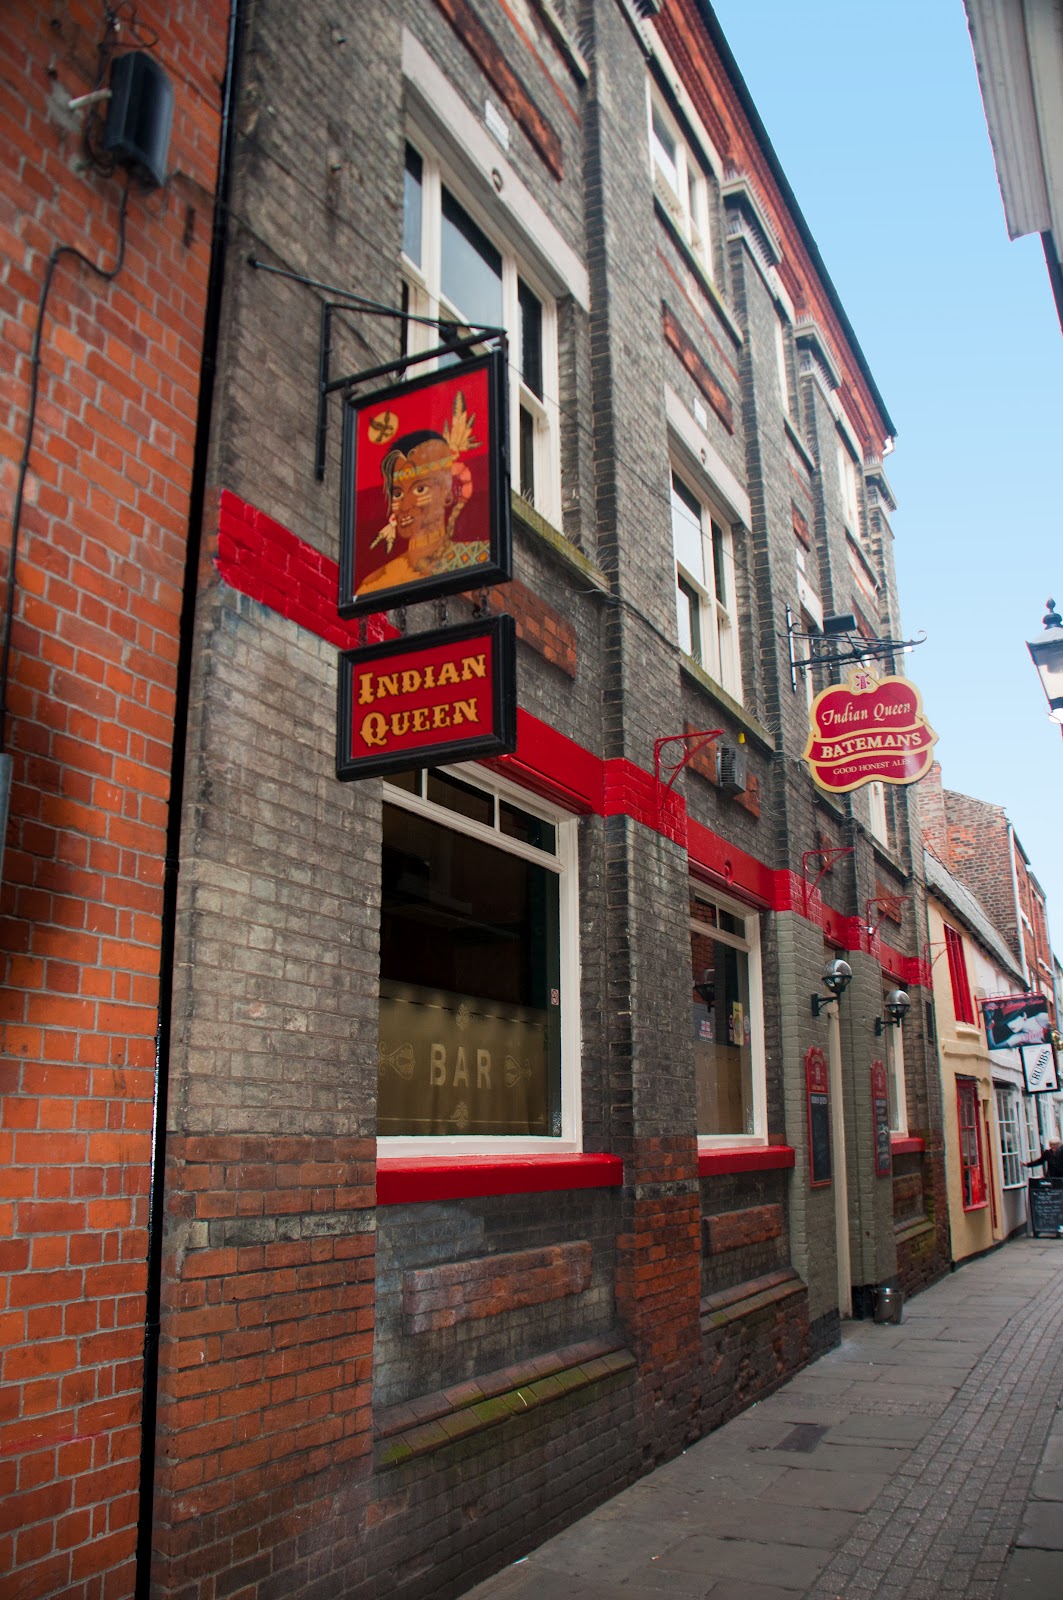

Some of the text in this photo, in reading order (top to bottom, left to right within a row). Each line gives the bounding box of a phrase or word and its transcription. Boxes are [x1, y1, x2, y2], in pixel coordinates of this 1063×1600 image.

[357, 653, 487, 706] INDIAN
[359, 697, 480, 748] QUEEN
[821, 701, 912, 726] Indian Queen
[820, 732, 923, 759] BATEMANS
[833, 758, 912, 775] GOOD HONEST ALES
[430, 1043, 493, 1090] BAR
[1030, 1050, 1051, 1086] CRUMBS
